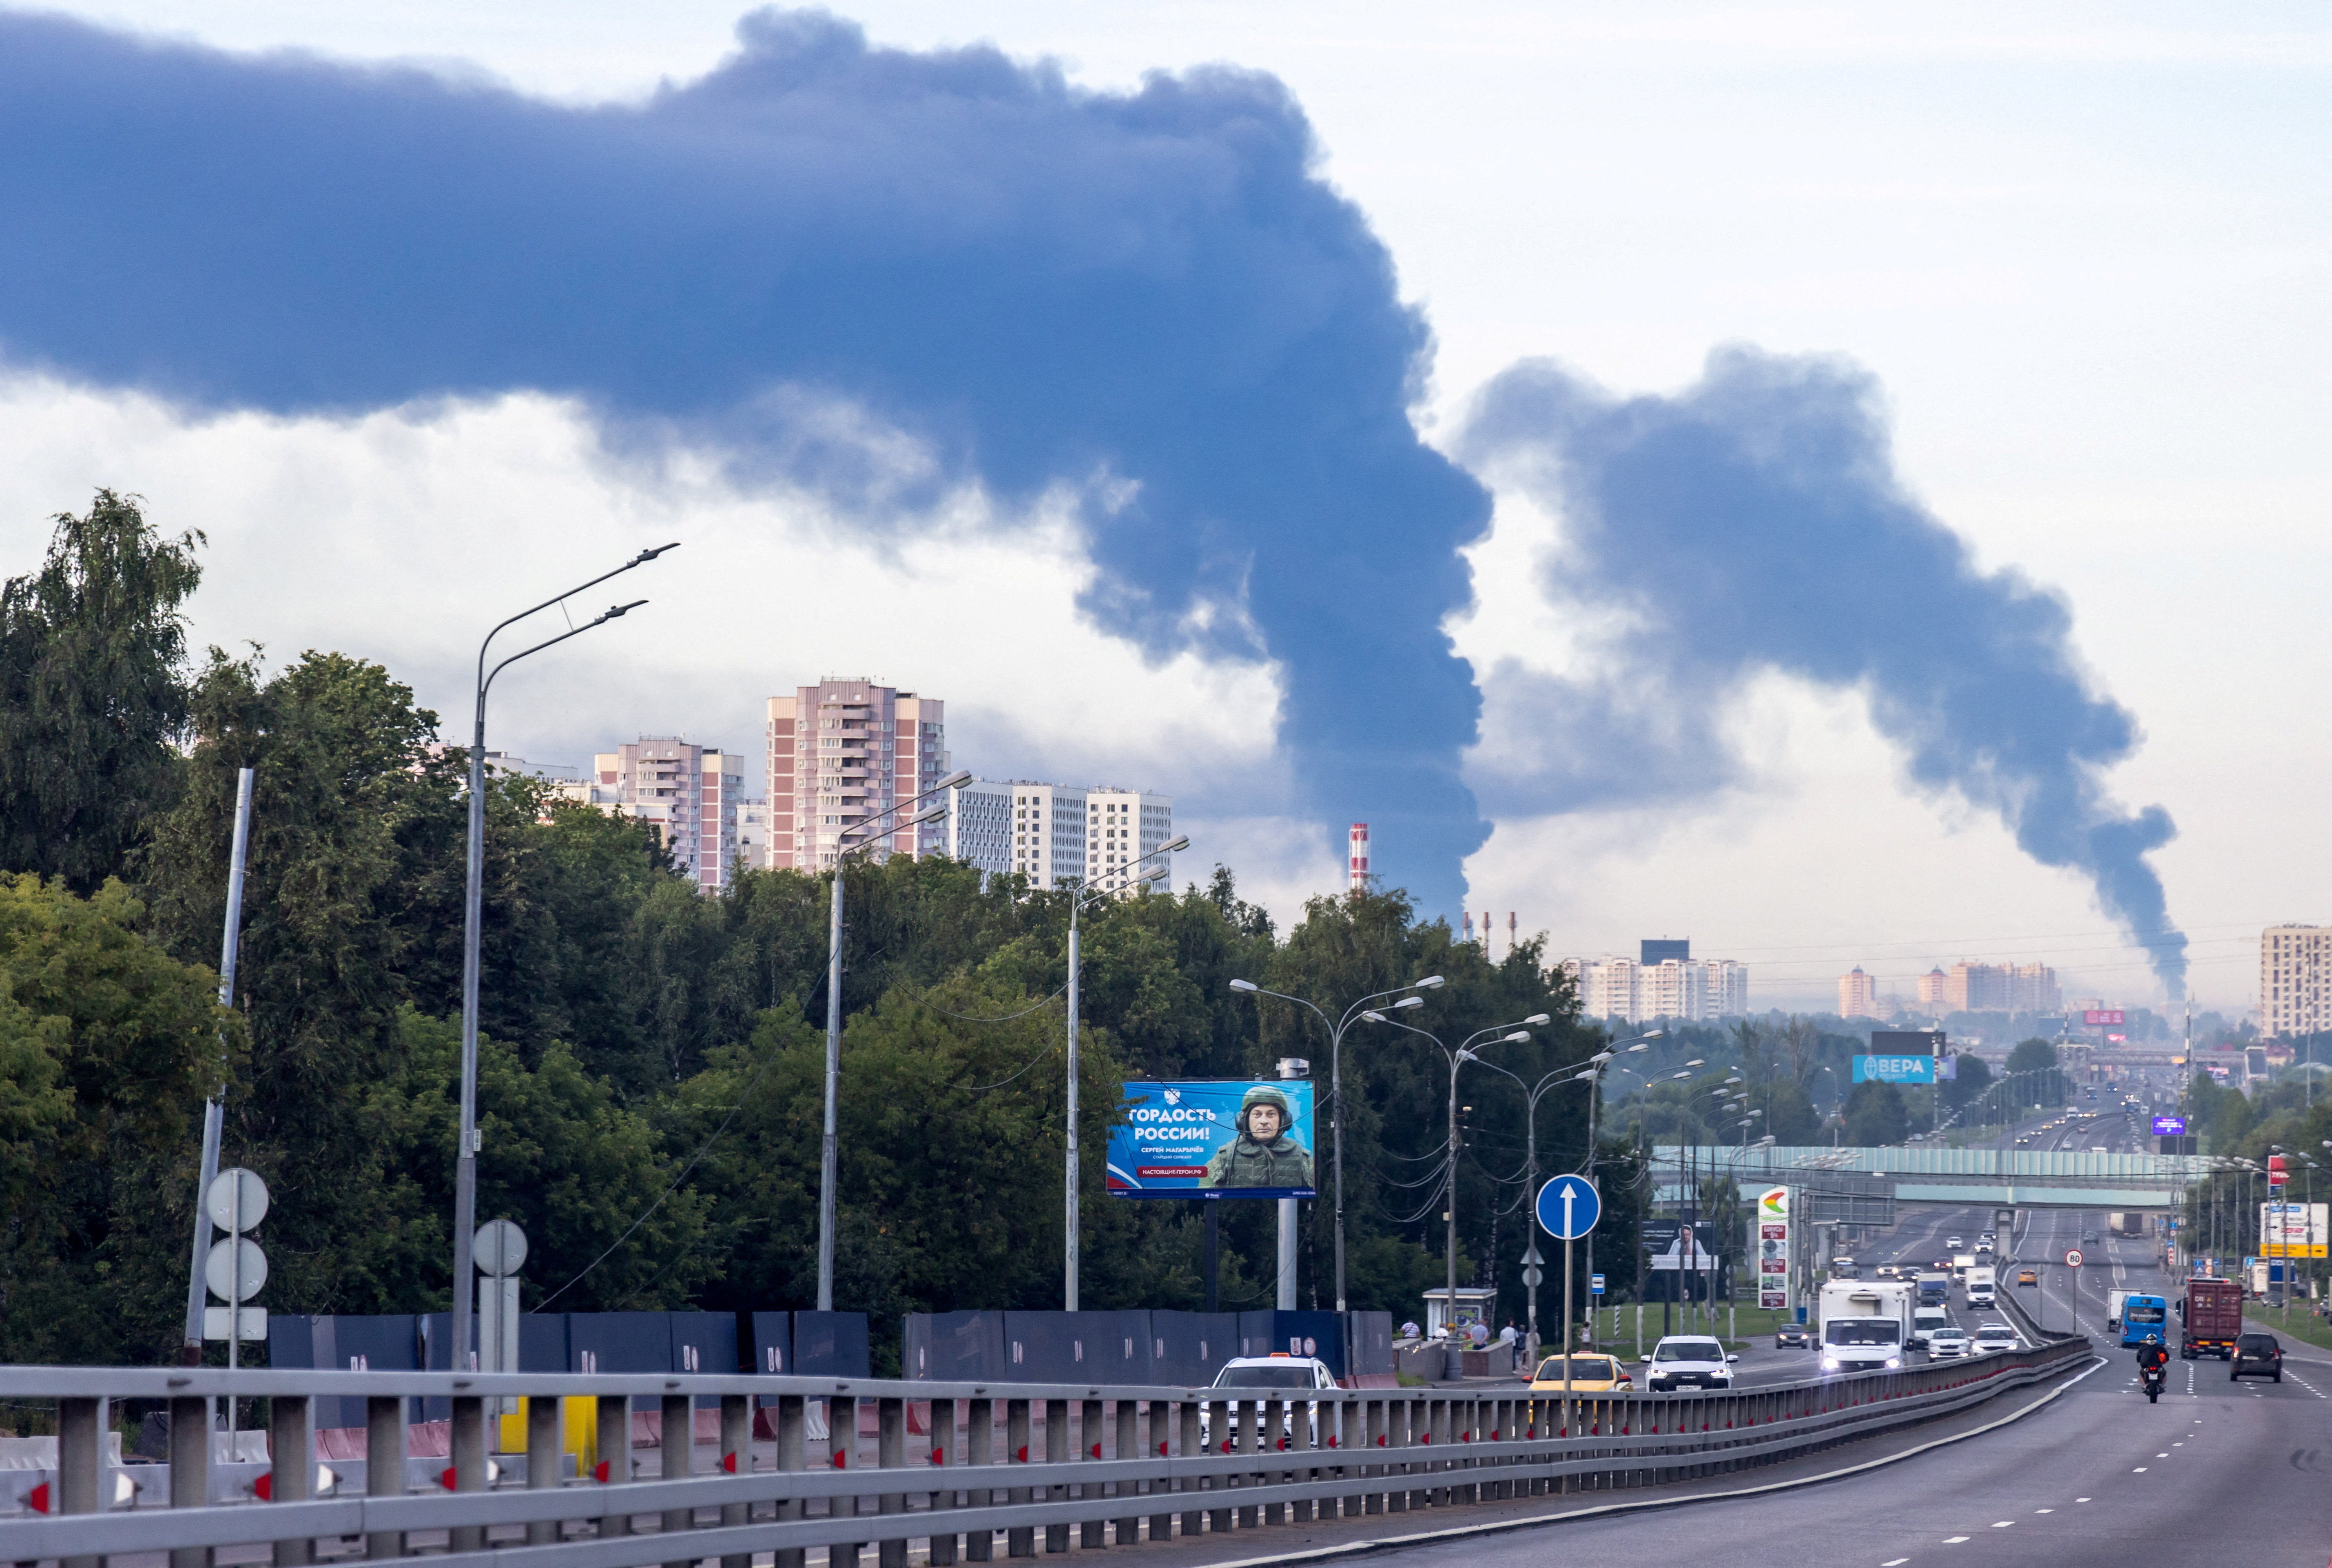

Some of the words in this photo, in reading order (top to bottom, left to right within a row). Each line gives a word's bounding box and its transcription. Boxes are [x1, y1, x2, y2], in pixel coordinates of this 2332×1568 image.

[1878, 1059, 1925, 1073] ВЕРА
[1129, 1108, 1216, 1123] ГОРДОСТЬ
[1134, 1127, 1210, 1141] РОССИИ!
